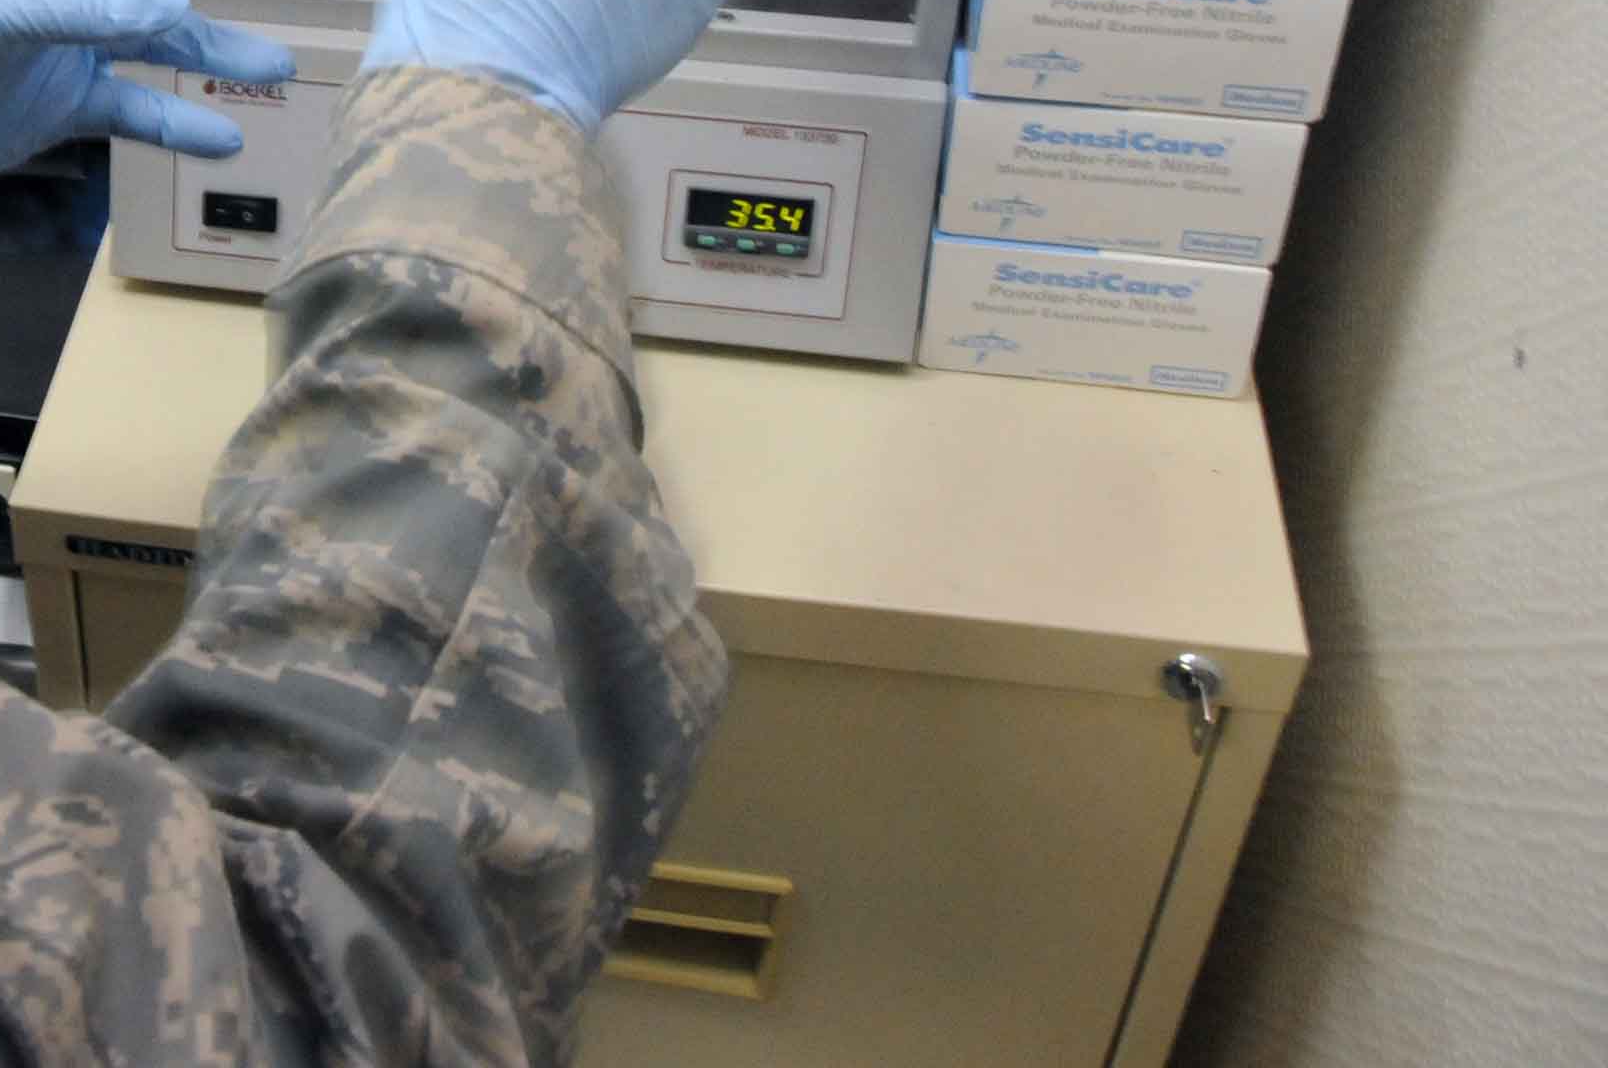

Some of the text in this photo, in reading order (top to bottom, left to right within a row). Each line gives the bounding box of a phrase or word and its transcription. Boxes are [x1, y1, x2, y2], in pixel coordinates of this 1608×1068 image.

[1203, 4, 1275, 25] Nitrile
[219, 81, 288, 101] BOEKEL
[1019, 122, 1225, 158] SensiCare
[994, 262, 1193, 298] SensiCare
